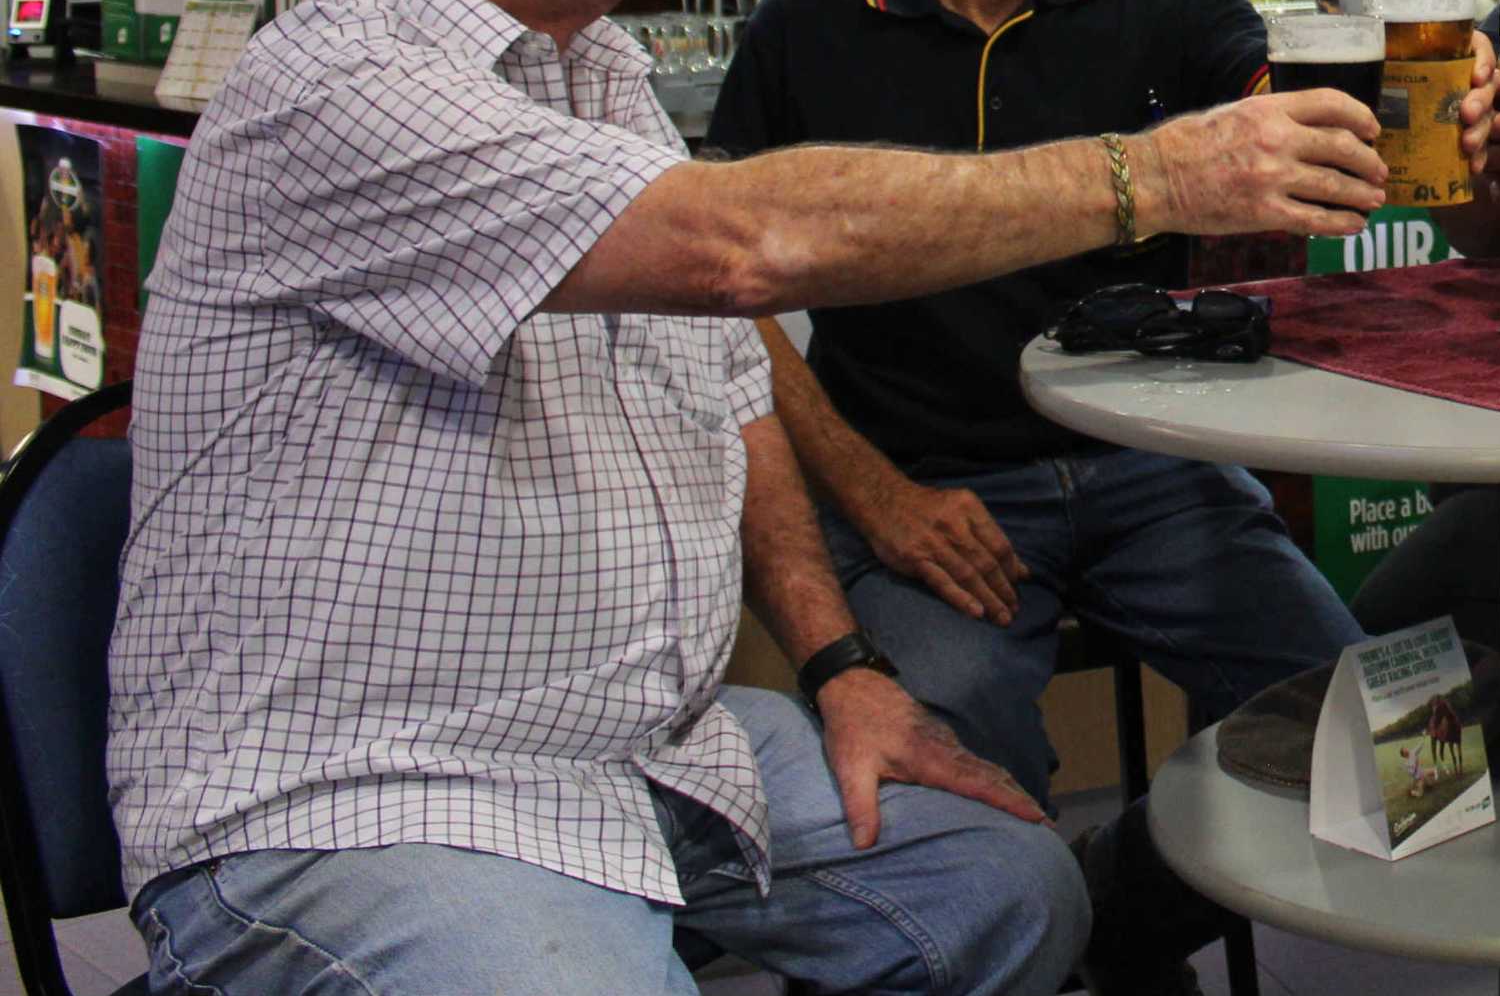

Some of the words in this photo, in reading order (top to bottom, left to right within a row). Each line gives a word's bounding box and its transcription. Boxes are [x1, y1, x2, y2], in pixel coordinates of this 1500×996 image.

[1344, 220, 1435, 272] OUR
[1349, 497, 1396, 525] Place
[1401, 497, 1411, 518] a
[1350, 525, 1389, 553] with
